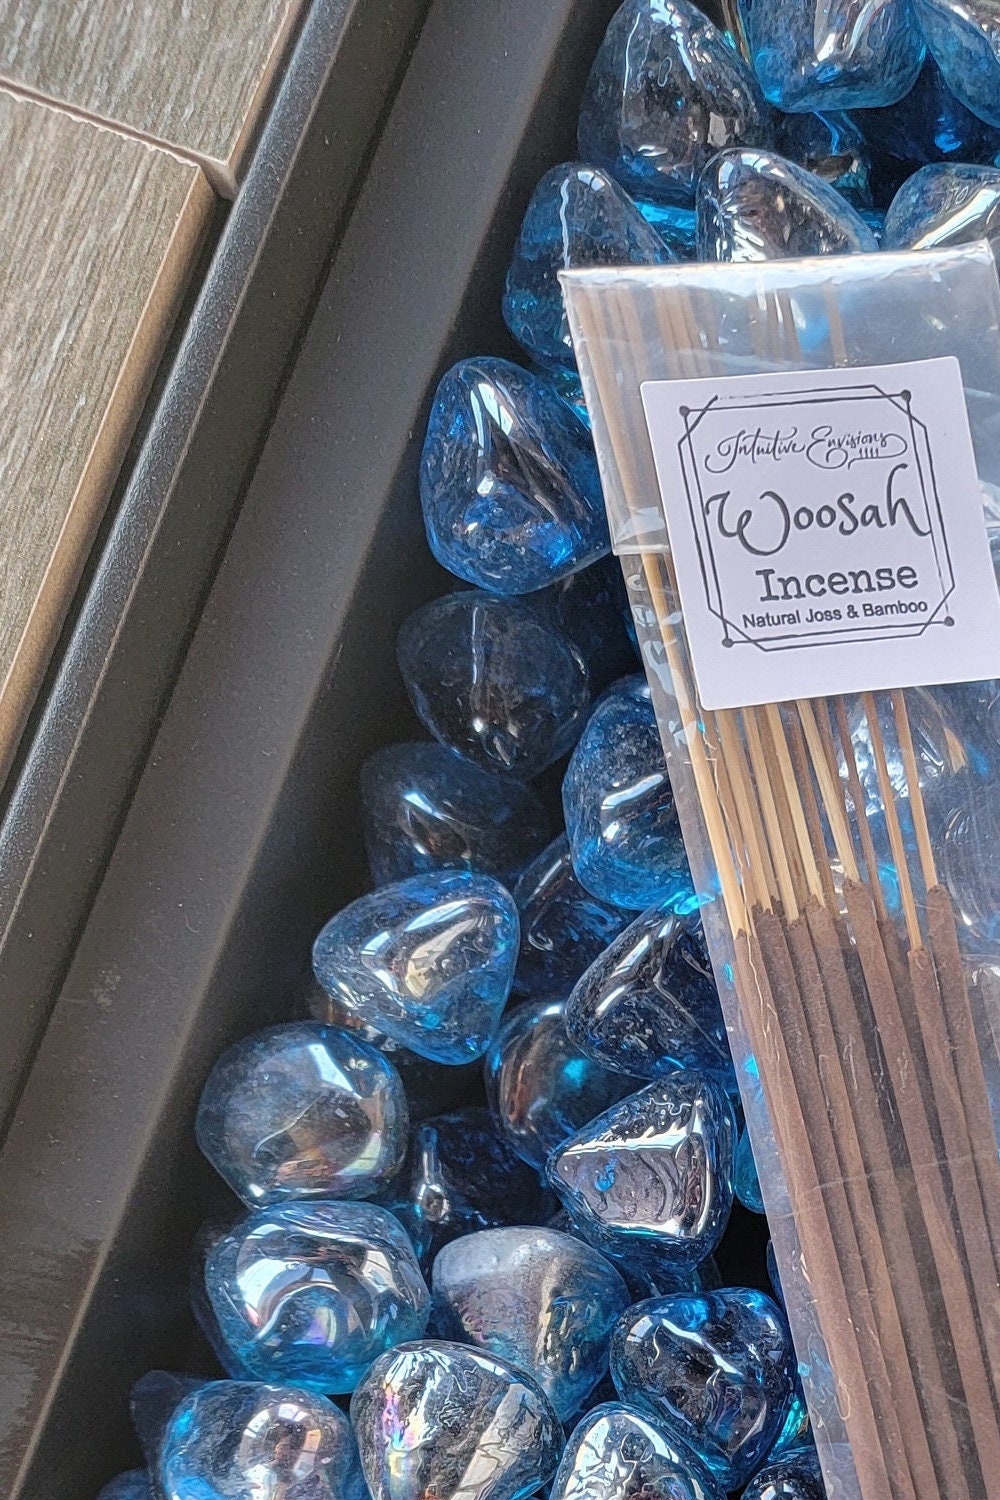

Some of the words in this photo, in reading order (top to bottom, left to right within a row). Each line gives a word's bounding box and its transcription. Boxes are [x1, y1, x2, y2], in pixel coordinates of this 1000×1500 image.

[705, 427, 805, 473] Intuitive
[705, 463, 932, 556] Woosah
[755, 564, 919, 602] Incense
[742, 610, 801, 629] Natural
[805, 605, 842, 623] Joss
[846, 604, 860, 618] &
[862, 600, 928, 617] Bamboo
